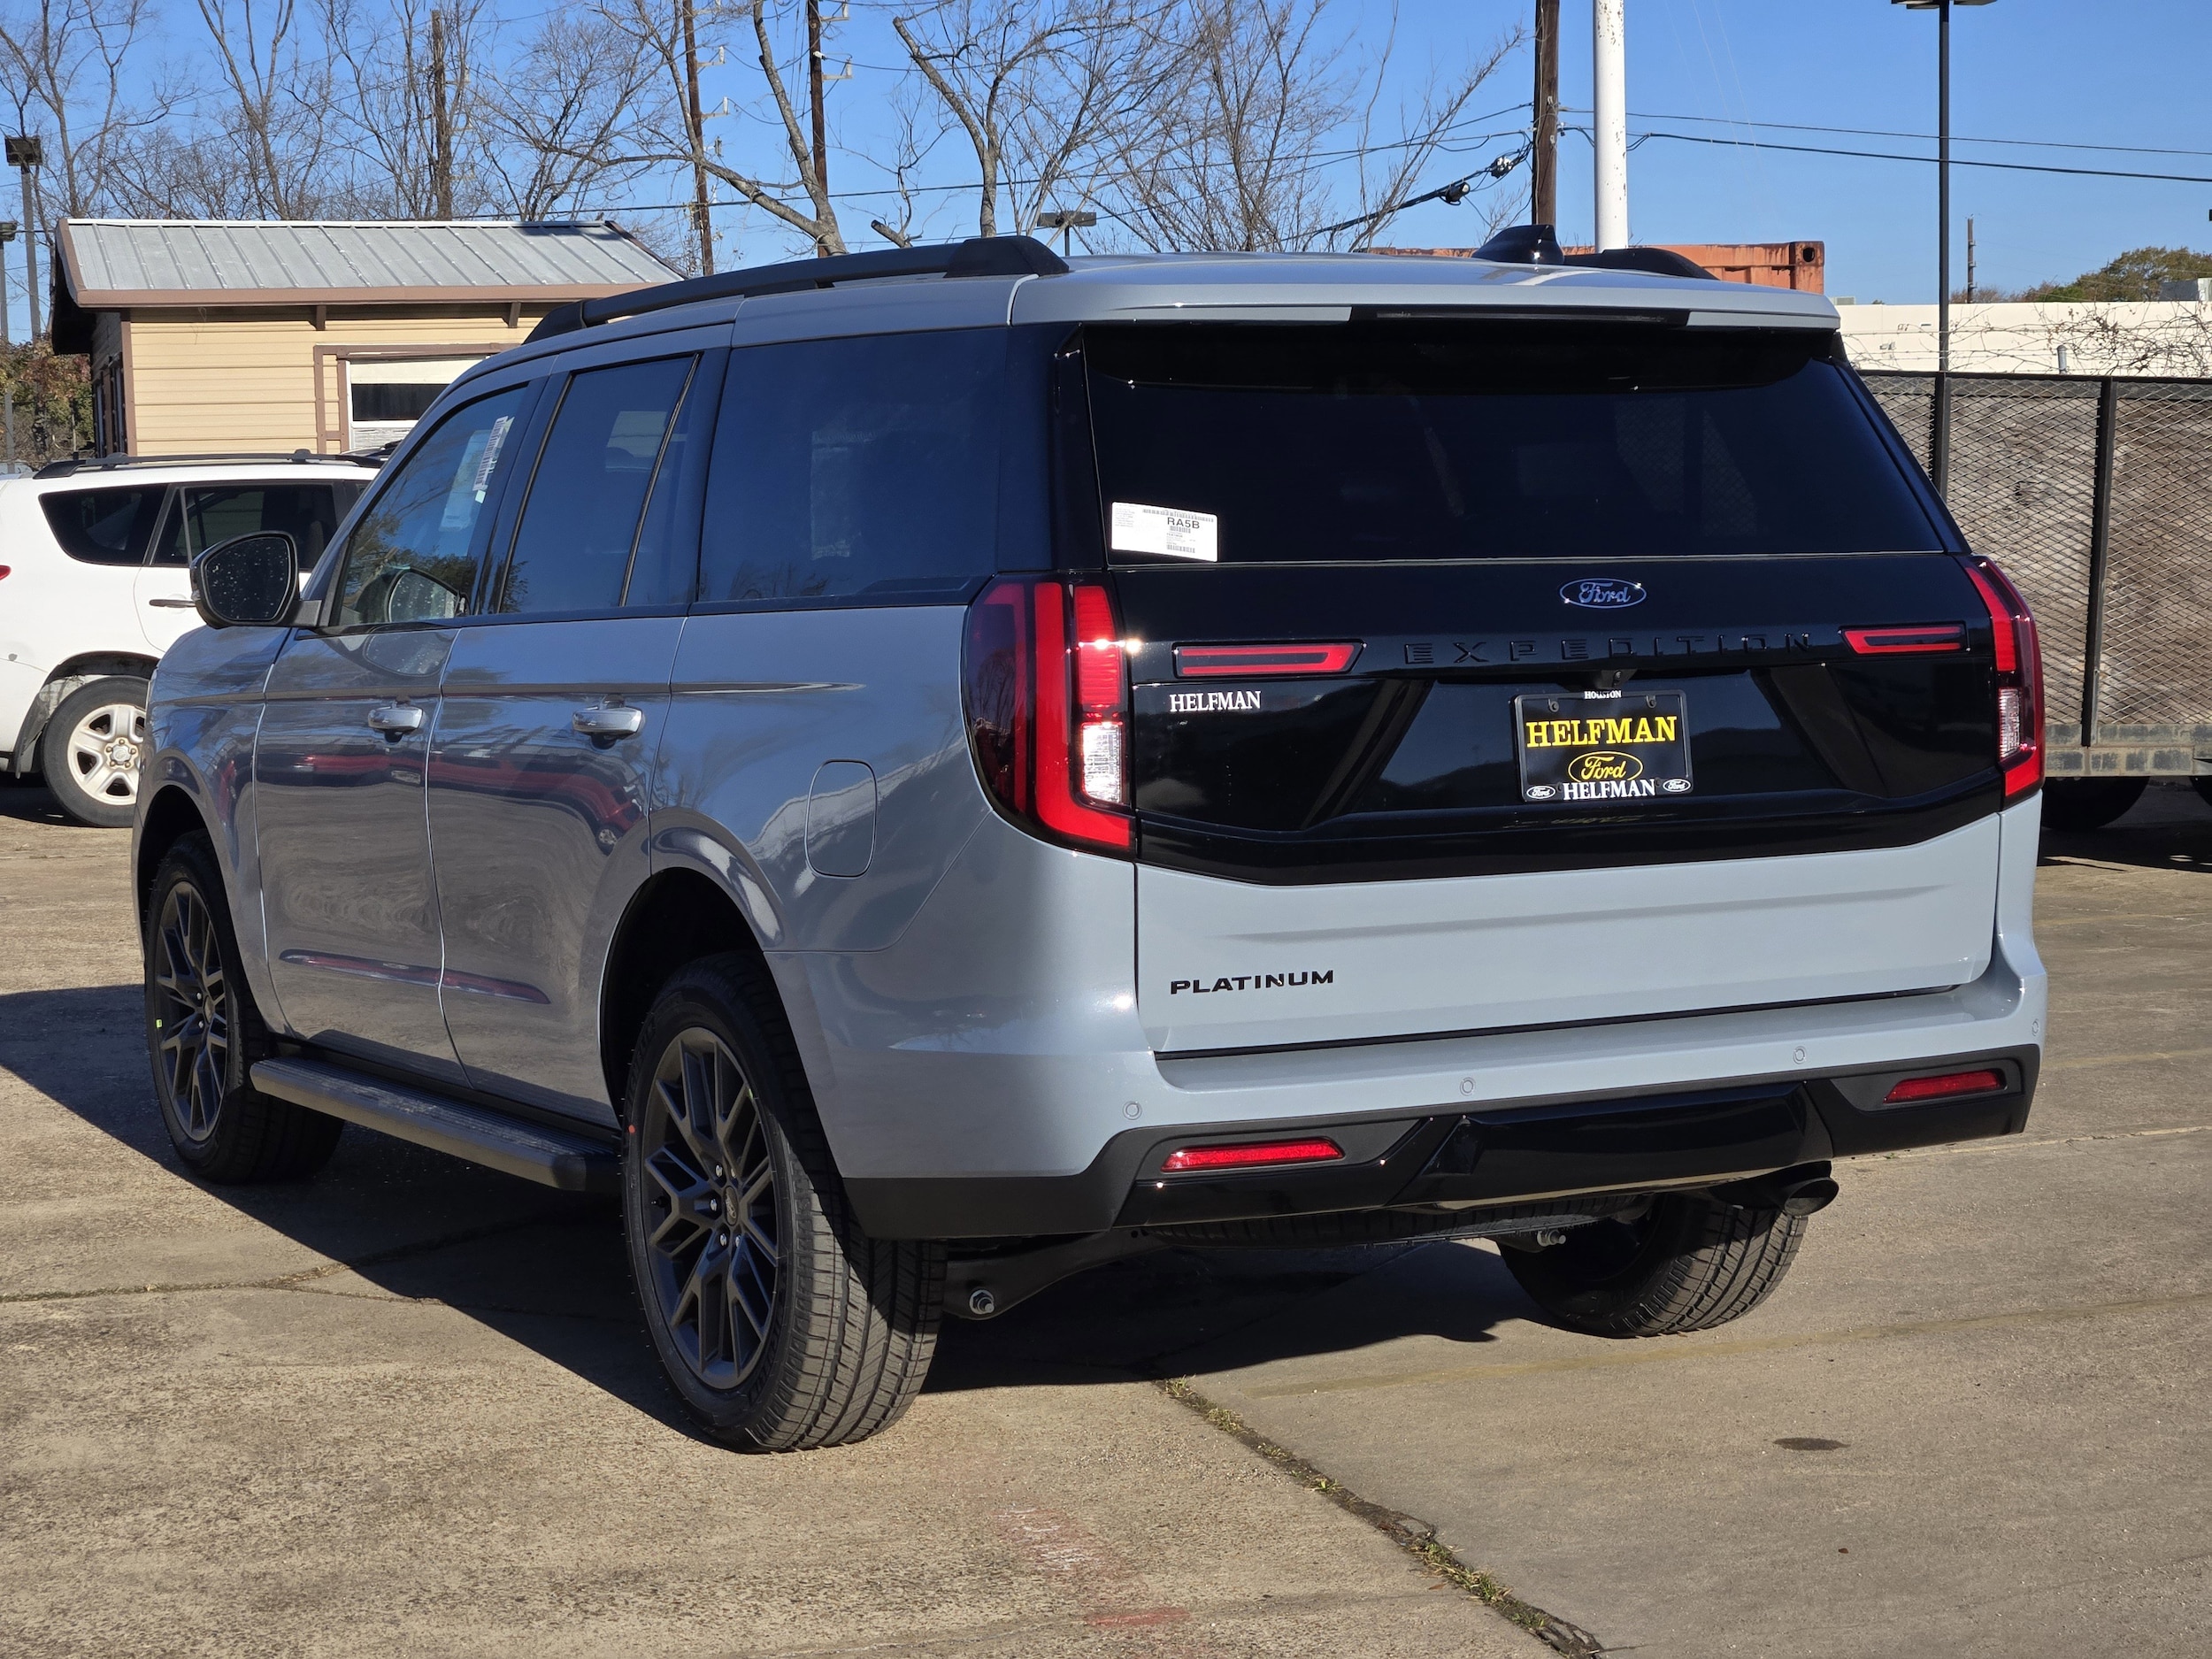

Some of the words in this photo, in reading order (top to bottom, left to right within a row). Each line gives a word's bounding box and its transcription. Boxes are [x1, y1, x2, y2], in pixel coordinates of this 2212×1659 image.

[1167, 517, 1201, 529] RA5B
[1578, 581, 1632, 603] Ford
[1404, 632, 1811, 664] EXPEDITION
[1169, 690, 1262, 712] HELFMAN
[1584, 690, 1622, 699] HOUSTON
[1525, 715, 1678, 748] HELFMAN
[1580, 756, 1627, 780] Ford
[1562, 779, 1656, 801] HELFMAN
[1171, 970, 1334, 995] PLATINUM
